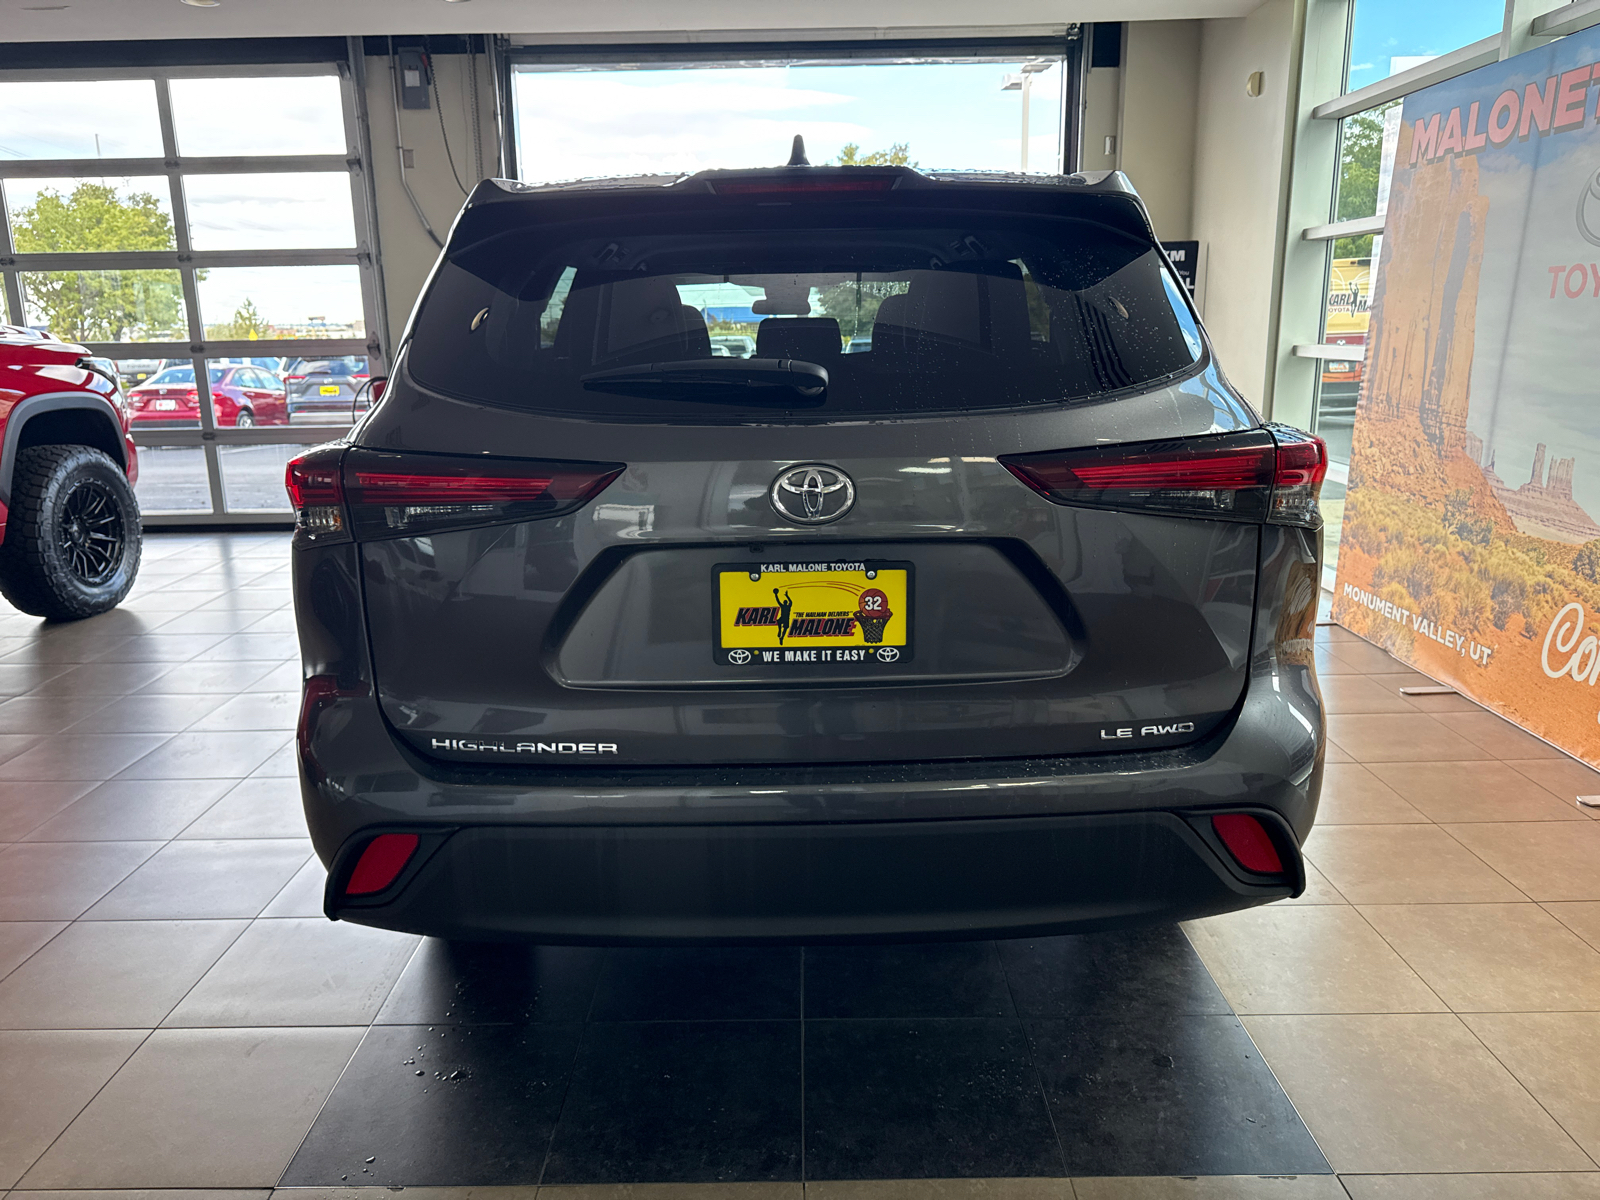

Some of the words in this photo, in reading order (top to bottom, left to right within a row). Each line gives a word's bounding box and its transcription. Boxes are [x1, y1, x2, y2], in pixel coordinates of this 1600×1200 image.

[1409, 61, 1600, 169] MALONE
[761, 564, 787, 573] KARL
[789, 563, 828, 572] MALONE
[830, 562, 866, 572] TOYOTA
[864, 596, 882, 611] 32
[734, 606, 780, 627] KARL
[1343, 582, 1410, 625] MONUMENT
[1412, 613, 1466, 657] VALLEY,
[1469, 641, 1492, 665] UT
[788, 617, 857, 638] MALONE
[762, 651, 780, 662] WE
[784, 650, 817, 662] MAKE
[822, 650, 834, 661] IT
[836, 649, 866, 661] EASY
[1100, 728, 1133, 740] LE
[1141, 722, 1195, 737] AWD
[431, 738, 619, 755] HIGHLANDER
